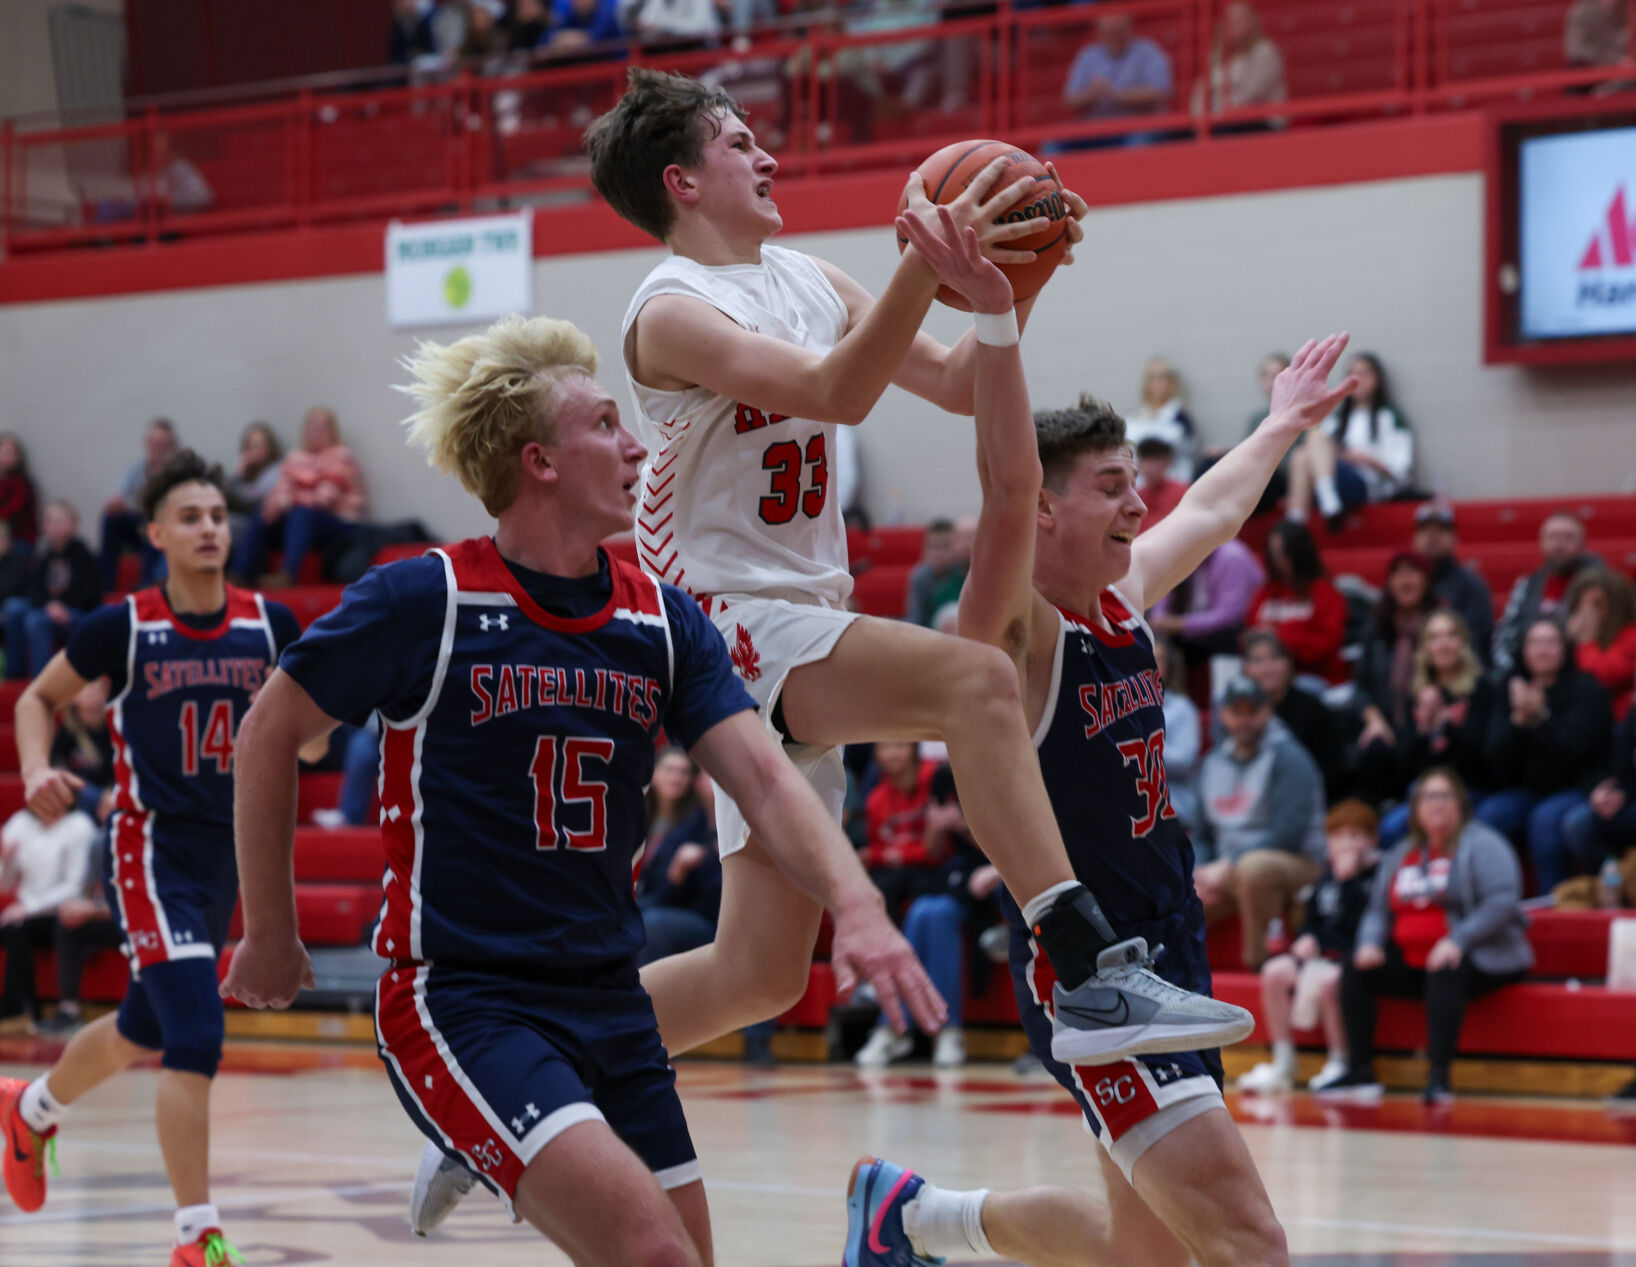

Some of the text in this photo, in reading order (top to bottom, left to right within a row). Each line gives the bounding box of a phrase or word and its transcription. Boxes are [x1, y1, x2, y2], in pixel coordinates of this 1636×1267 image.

[992, 189, 1065, 225] Wilso
[758, 432, 828, 525] 33
[144, 658, 265, 699] SATELLITES
[470, 664, 662, 732] SATELLITES
[1078, 668, 1164, 740] SATELLITE
[178, 700, 235, 777] 14
[528, 735, 615, 852] 15
[1095, 1074, 1136, 1106] SC
